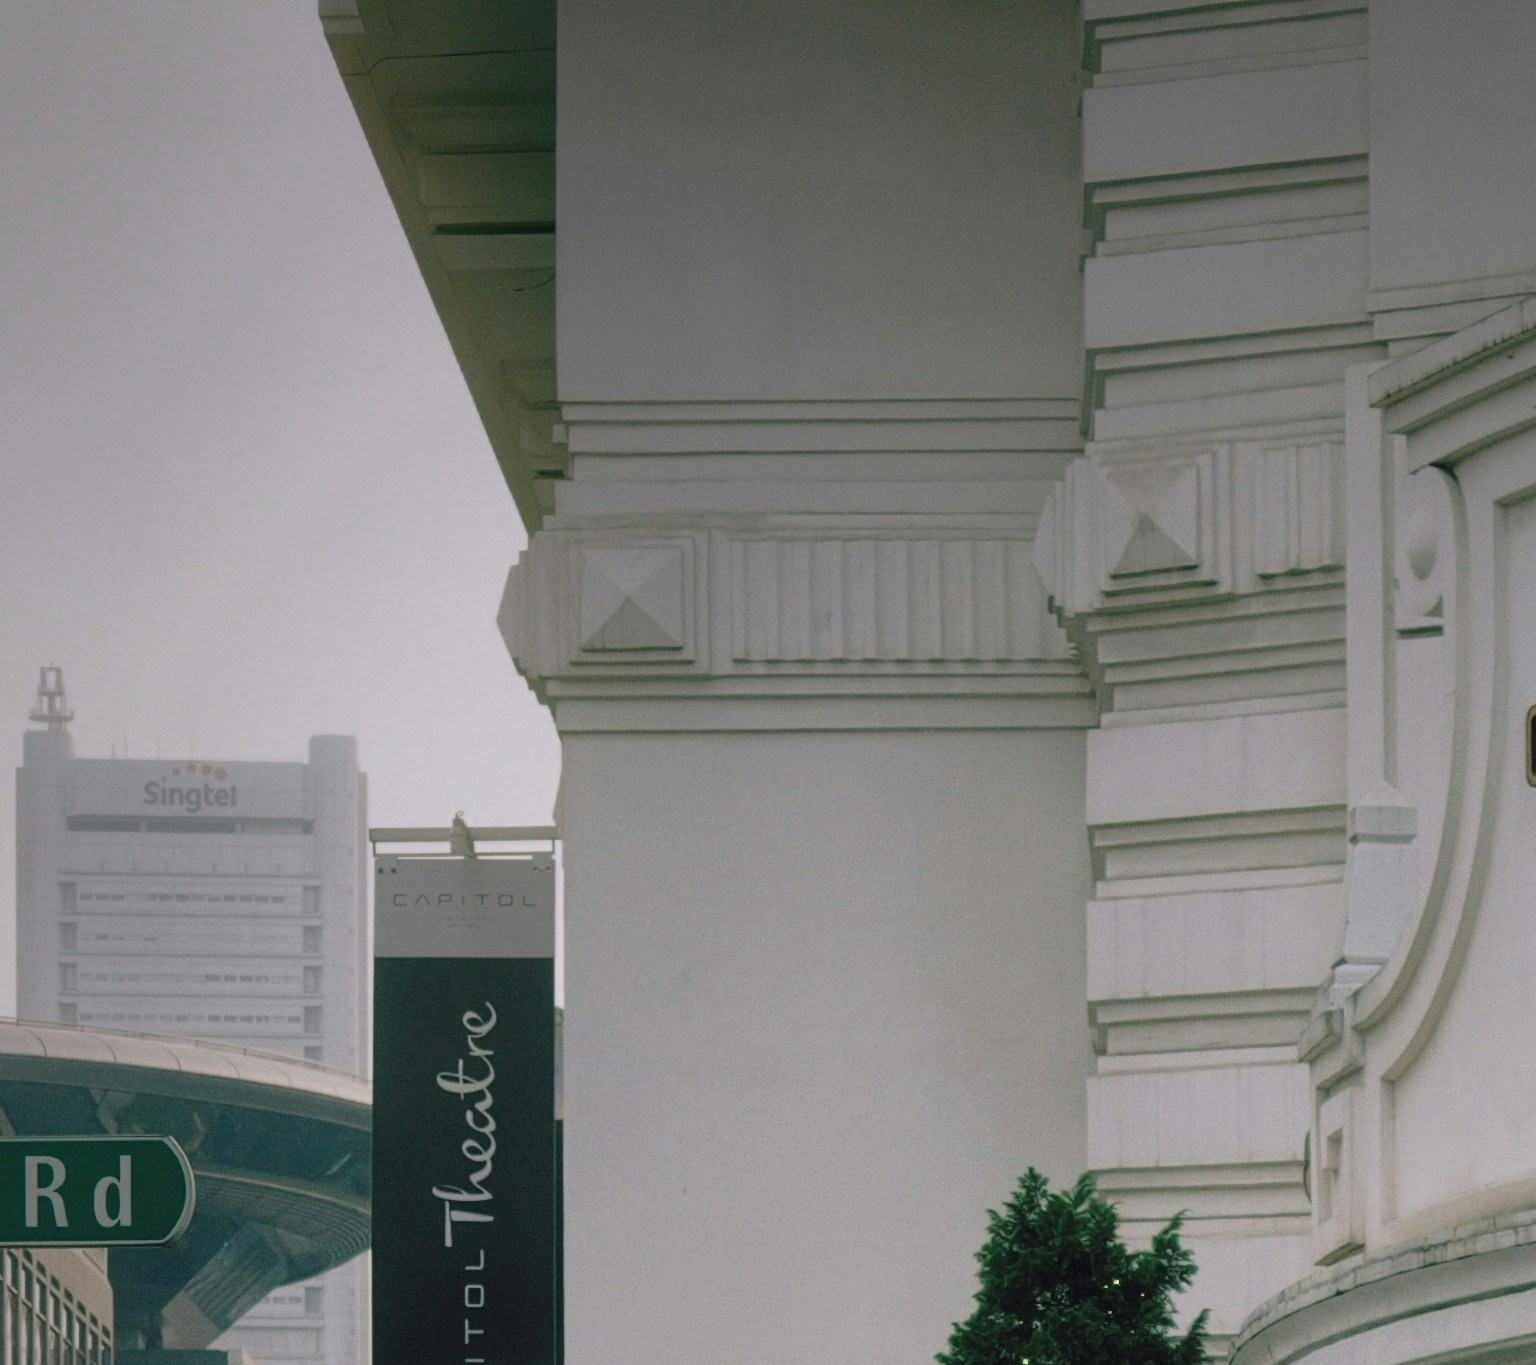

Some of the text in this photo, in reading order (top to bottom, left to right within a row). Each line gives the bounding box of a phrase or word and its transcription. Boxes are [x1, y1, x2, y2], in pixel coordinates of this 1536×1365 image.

[143, 778, 238, 813] Singtel
[393, 893, 537, 907] CAPITOL
[433, 1001, 498, 1248] Theatre
[24, 1154, 133, 1229] Rd
